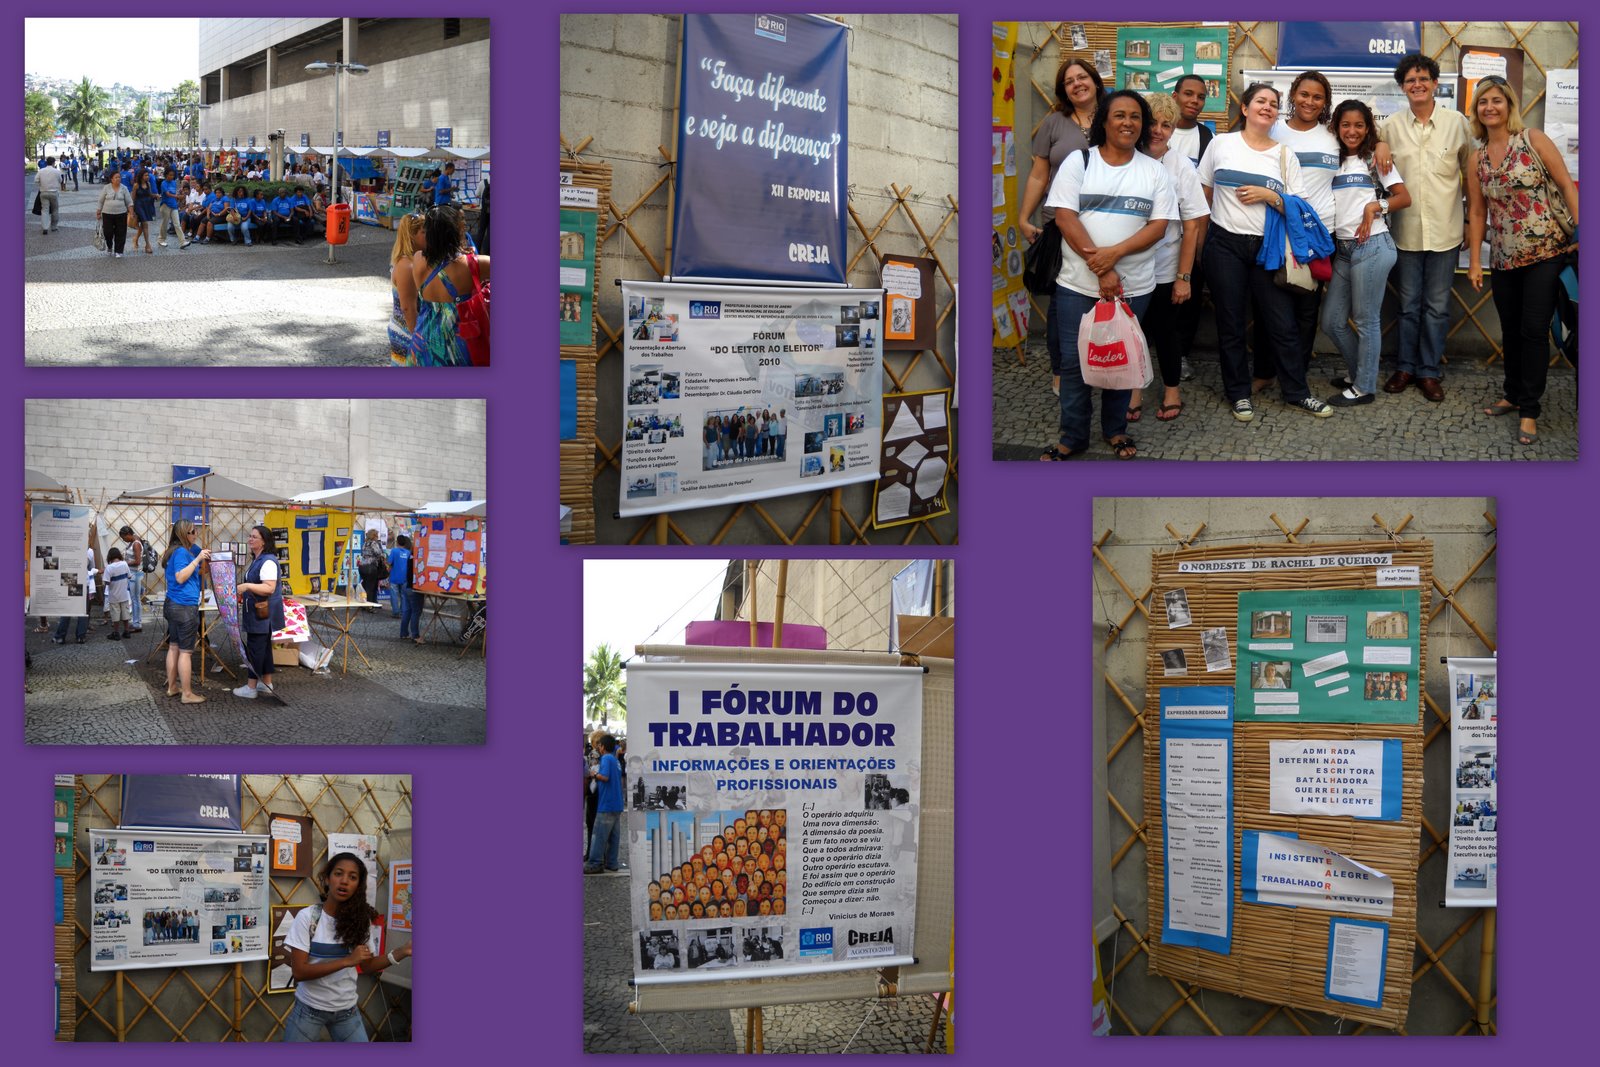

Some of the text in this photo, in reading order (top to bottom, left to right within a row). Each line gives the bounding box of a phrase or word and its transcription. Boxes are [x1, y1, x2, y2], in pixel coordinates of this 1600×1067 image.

[771, 21, 784, 32] RIO
[1369, 39, 1406, 54] CREJA
[759, 73, 827, 112] diferente
[685, 115, 695, 134] e
[700, 114, 738, 150] seja
[742, 126, 754, 145] a
[771, 184, 830, 203] XII EXPOPEJA
[789, 243, 830, 264] CREJA
[704, 306, 718, 314] RIO
[753, 332, 785, 340] FÓRUM
[732, 345, 765, 353] LEITOR
[768, 345, 780, 353] AO
[1089, 349, 1125, 362] Leader
[759, 358, 780, 366] 2010
[1191, 562, 1245, 571] NORDESTE
[1251, 560, 1267, 569] DE
[1271, 559, 1315, 568] RACHEL
[1320, 557, 1336, 566] DE
[1338, 556, 1388, 567] QUEIROZ
[669, 683, 878, 716] I FÓRUM DO
[649, 722, 895, 746] TRABALHADOR
[653, 758, 895, 773] INFORMAÇÕES E ORIENTAÇÕES
[717, 779, 837, 791] PROFISSIONAIS
[200, 805, 229, 818] CREJA
[811, 811, 842, 819] operário
[844, 810, 874, 818] adquiriu
[810, 828, 846, 836] dimensão
[859, 828, 884, 836] poesia.
[811, 856, 824, 864] que
[833, 854, 863, 862] operário
[825, 863, 855, 871] operário
[866, 870, 895, 878] operário
[1325, 870, 1369, 880] ALEGRE
[856, 878, 895, 886] construção
[1262, 875, 1331, 890] TRABALHADOR
[819, 889, 846, 897] sempre
[802, 898, 837, 906] Começou
[816, 933, 831, 941] RIO
[848, 927, 893, 946] CREJA
